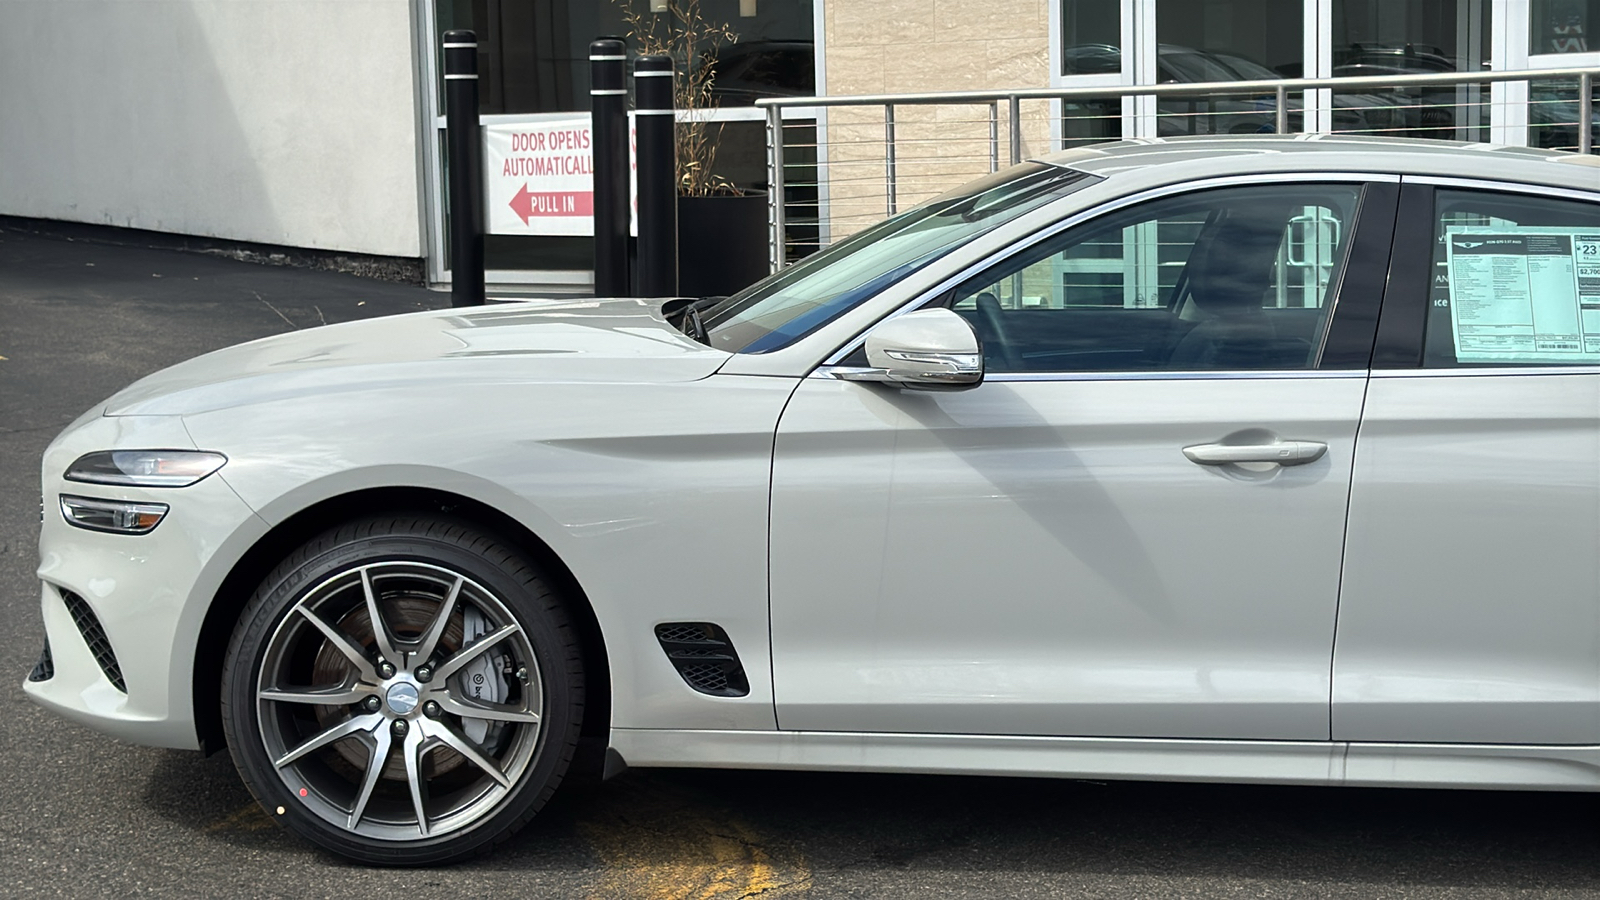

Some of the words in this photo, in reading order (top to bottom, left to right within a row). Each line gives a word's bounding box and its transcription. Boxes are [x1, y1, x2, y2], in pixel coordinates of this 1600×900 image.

[512, 132, 545, 152] DOOR
[548, 129, 590, 151] OPENS
[531, 195, 559, 213] PULL
[563, 195, 575, 212] IN
[1582, 244, 1597, 255] 23
